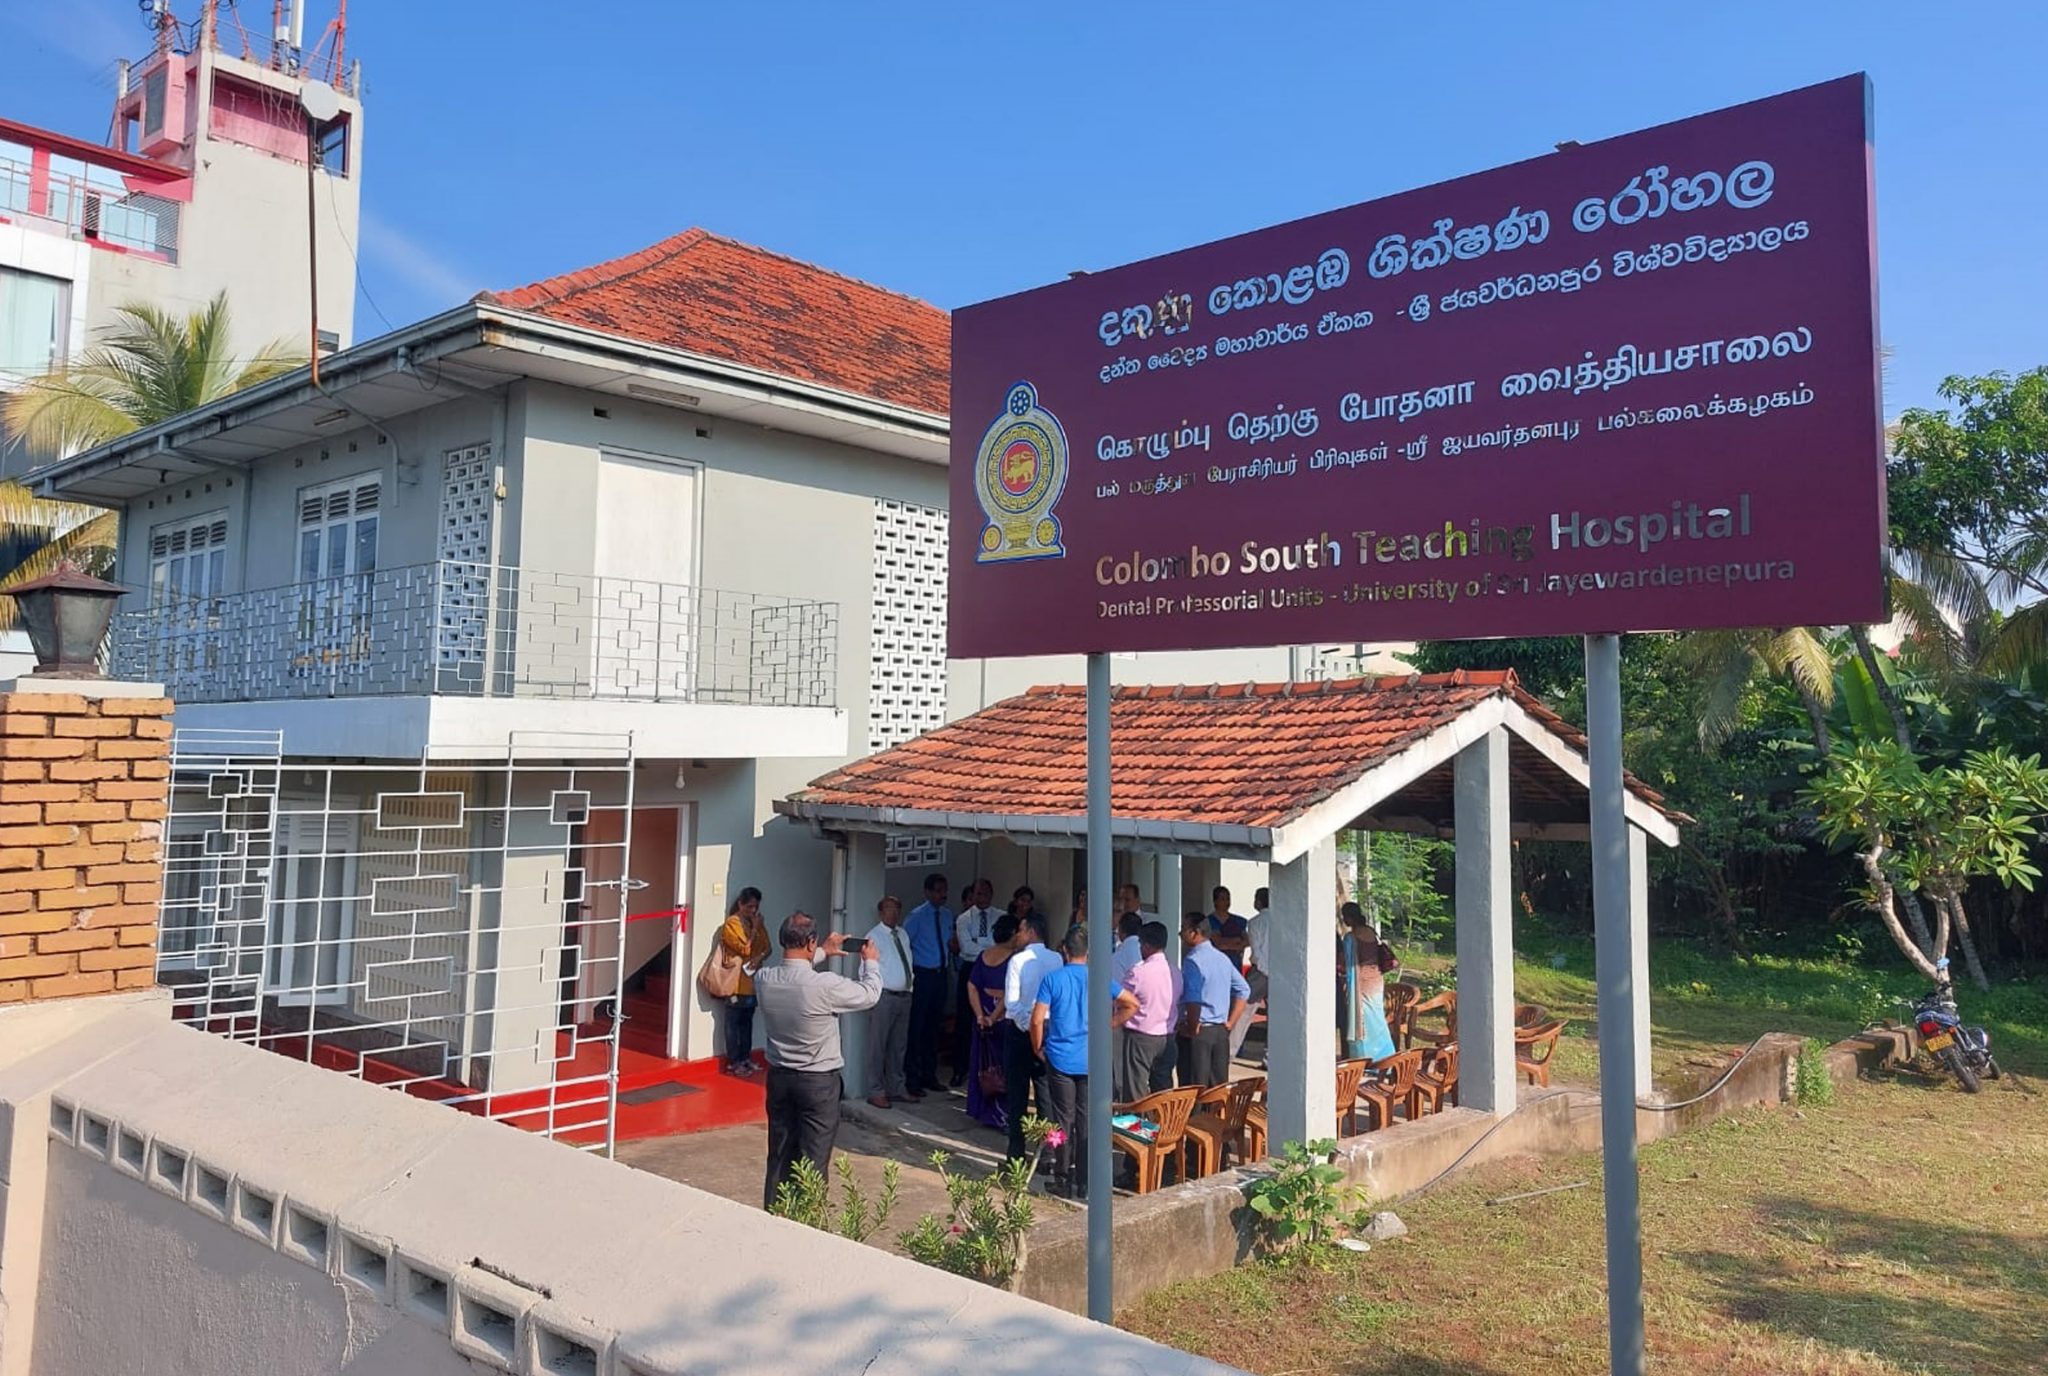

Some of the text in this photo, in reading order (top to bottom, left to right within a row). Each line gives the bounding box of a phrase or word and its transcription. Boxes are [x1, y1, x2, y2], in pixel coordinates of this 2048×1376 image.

[1207, 248, 1350, 315] කොළඹ
[1368, 206, 1550, 279] ශික්ෂණ
[1572, 160, 1775, 233] රෝහල
[1097, 326, 1813, 461] கொழும்பு தெற்கு போதனா வைத்தியசாலை
[1099, 356, 1142, 383] දන්ත
[1316, 311, 1374, 336] ඒකක
[1096, 479, 1120, 498] பல்
[1207, 453, 1298, 485] பேராசிரியர்
[1309, 441, 1388, 472] பிரிவுகள்
[1597, 382, 1814, 432] பல்கலைக்கழகம்
[1096, 493, 1751, 585] Colombo South Teaching Hospital
[1099, 596, 1151, 618] Dental
[1271, 586, 1324, 608] Units
[1343, 576, 1459, 603] University
[1466, 572, 1492, 597] of
[1536, 559, 1795, 597] Jayewardenepura
